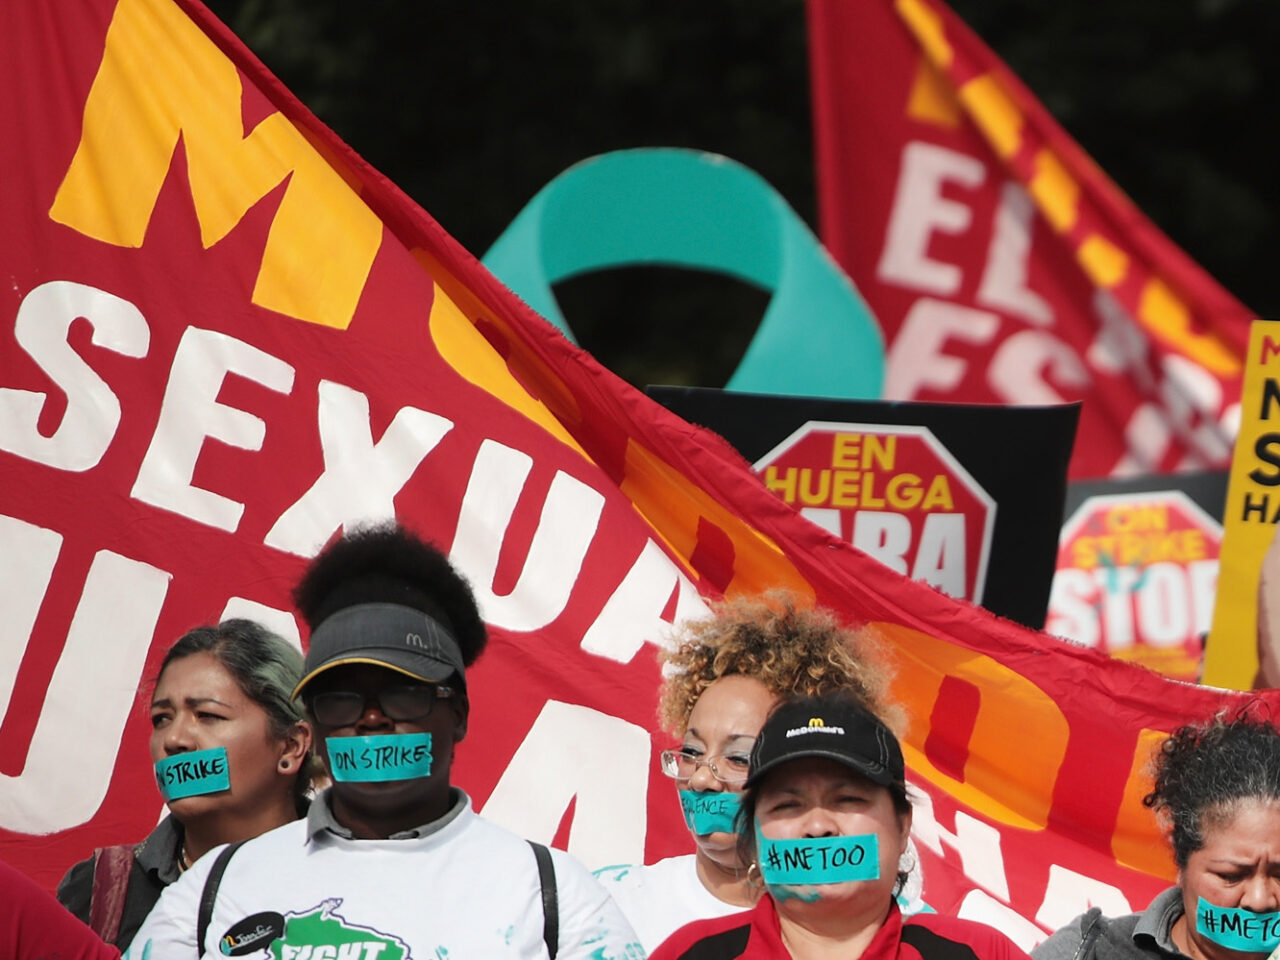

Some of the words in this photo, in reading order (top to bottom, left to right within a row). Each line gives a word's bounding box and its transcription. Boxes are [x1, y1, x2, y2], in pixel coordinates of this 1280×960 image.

[832, 433, 897, 471] EN
[0, 281, 716, 664] SEXUA
[765, 465, 955, 511] HUELGA
[165, 756, 225, 785] STRIKE
[335, 751, 356, 771] ON
[361, 745, 432, 770] STRIKE
